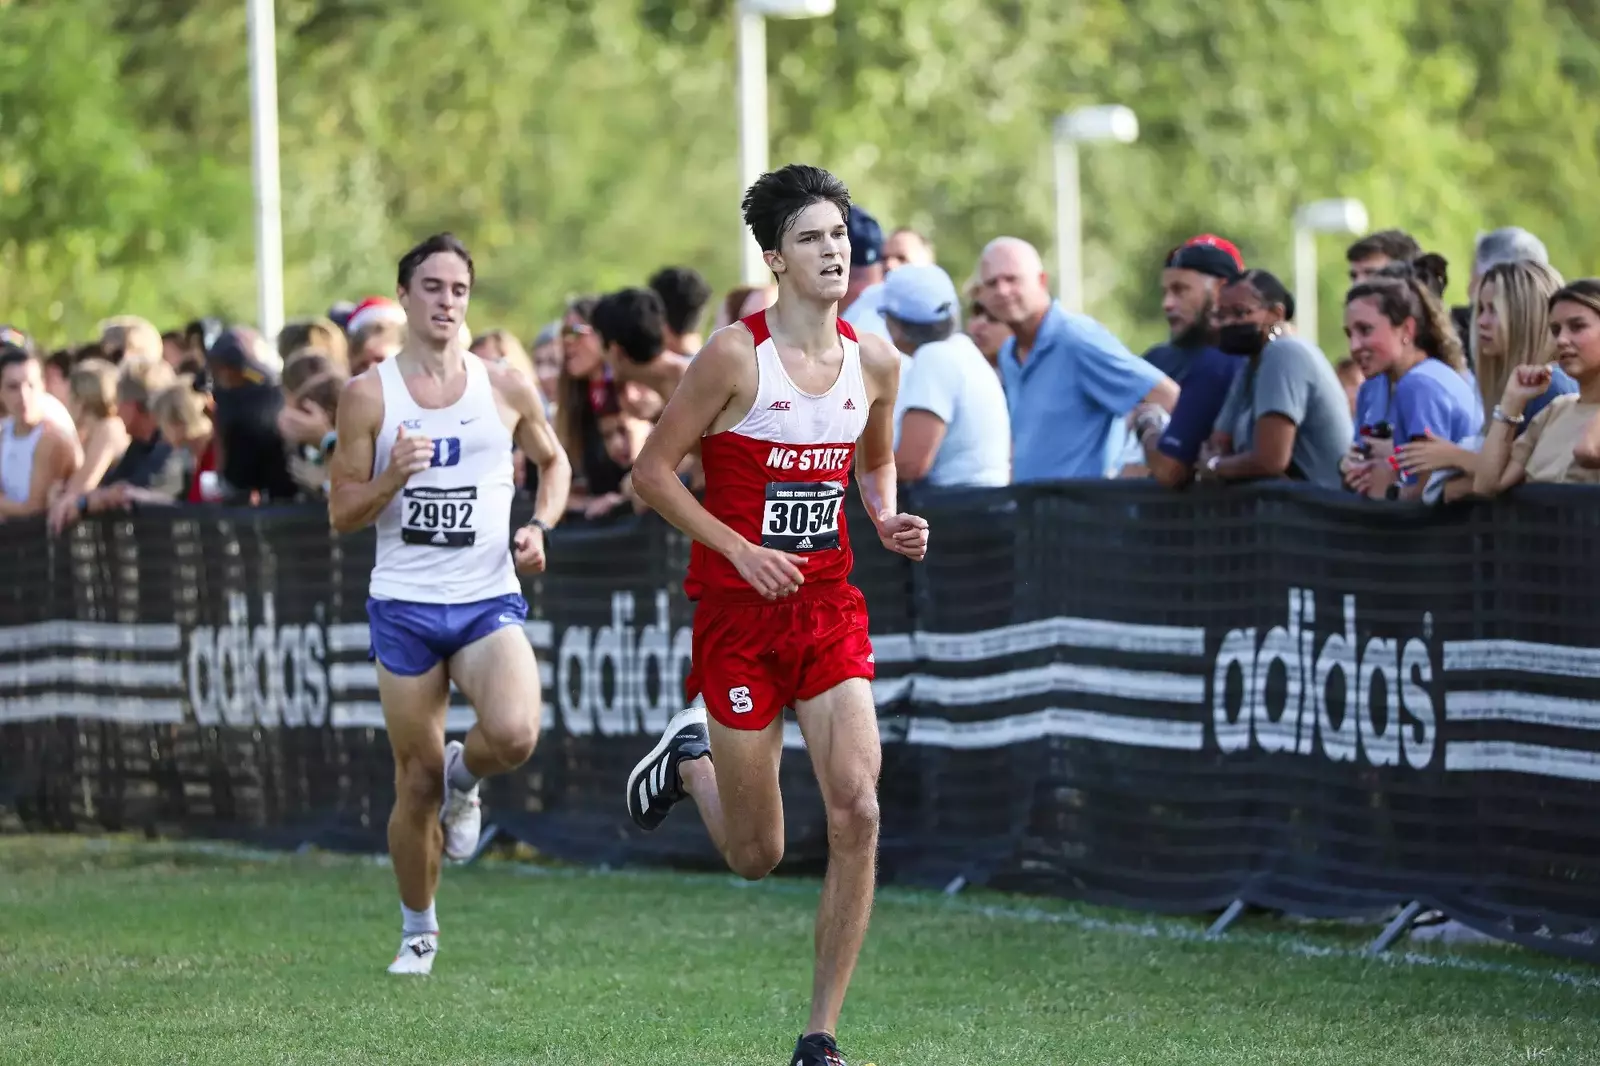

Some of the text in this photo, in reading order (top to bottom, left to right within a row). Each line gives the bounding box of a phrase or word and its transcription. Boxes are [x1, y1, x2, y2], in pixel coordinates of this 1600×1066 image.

[767, 401, 791, 411] ACC
[766, 447, 850, 471] NC STATE
[408, 501, 473, 529] 2992
[769, 500, 838, 534] 3034
[188, 590, 328, 728] adidas
[1213, 587, 1436, 770] adidas
